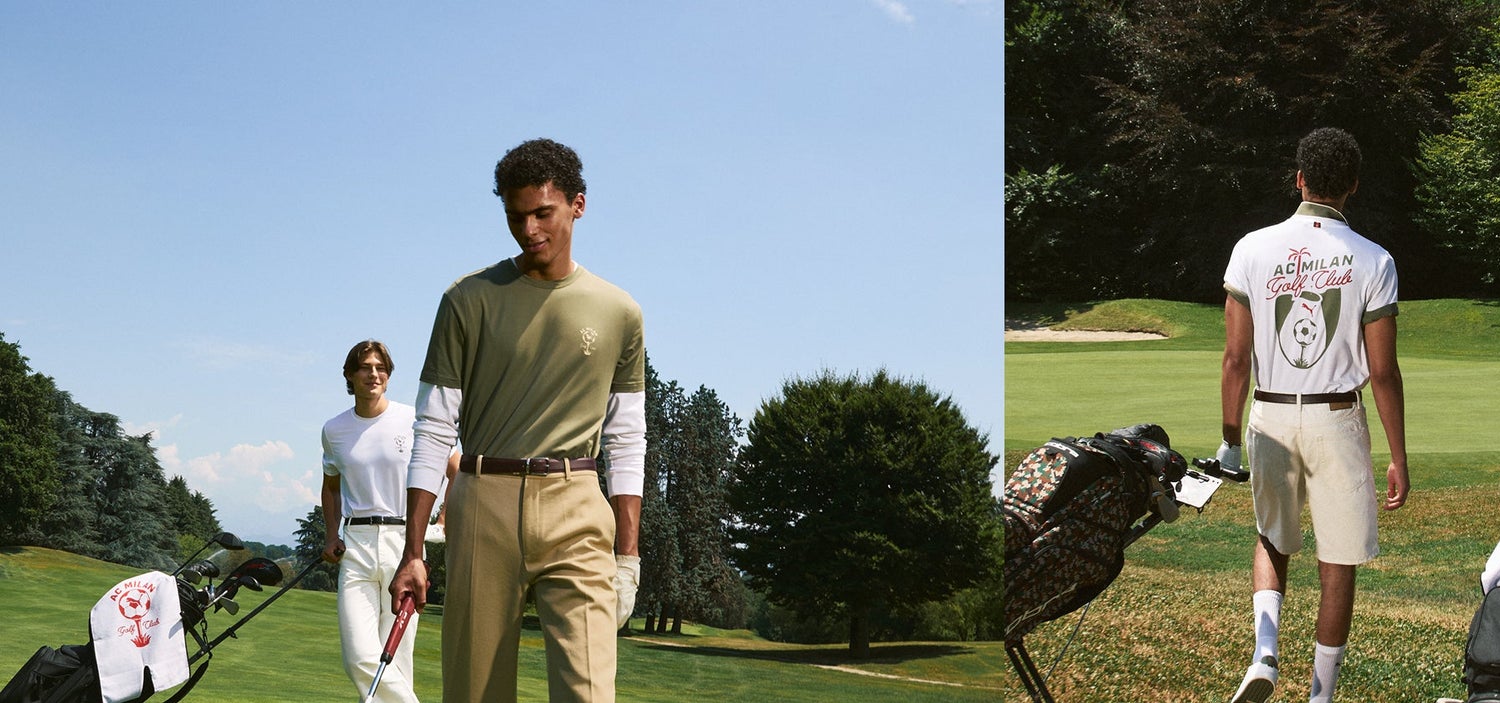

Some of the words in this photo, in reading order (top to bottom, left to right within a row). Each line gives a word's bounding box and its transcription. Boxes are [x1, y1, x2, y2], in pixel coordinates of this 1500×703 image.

[1273, 262, 1295, 277] AC
[1301, 254, 1354, 273] MILAN
[1265, 273, 1308, 301] Golf
[1311, 268, 1353, 289] Club
[110, 587, 122, 602] AC
[124, 581, 156, 593] MILAN
[118, 624, 136, 637] Golf
[143, 617, 160, 629] Club
